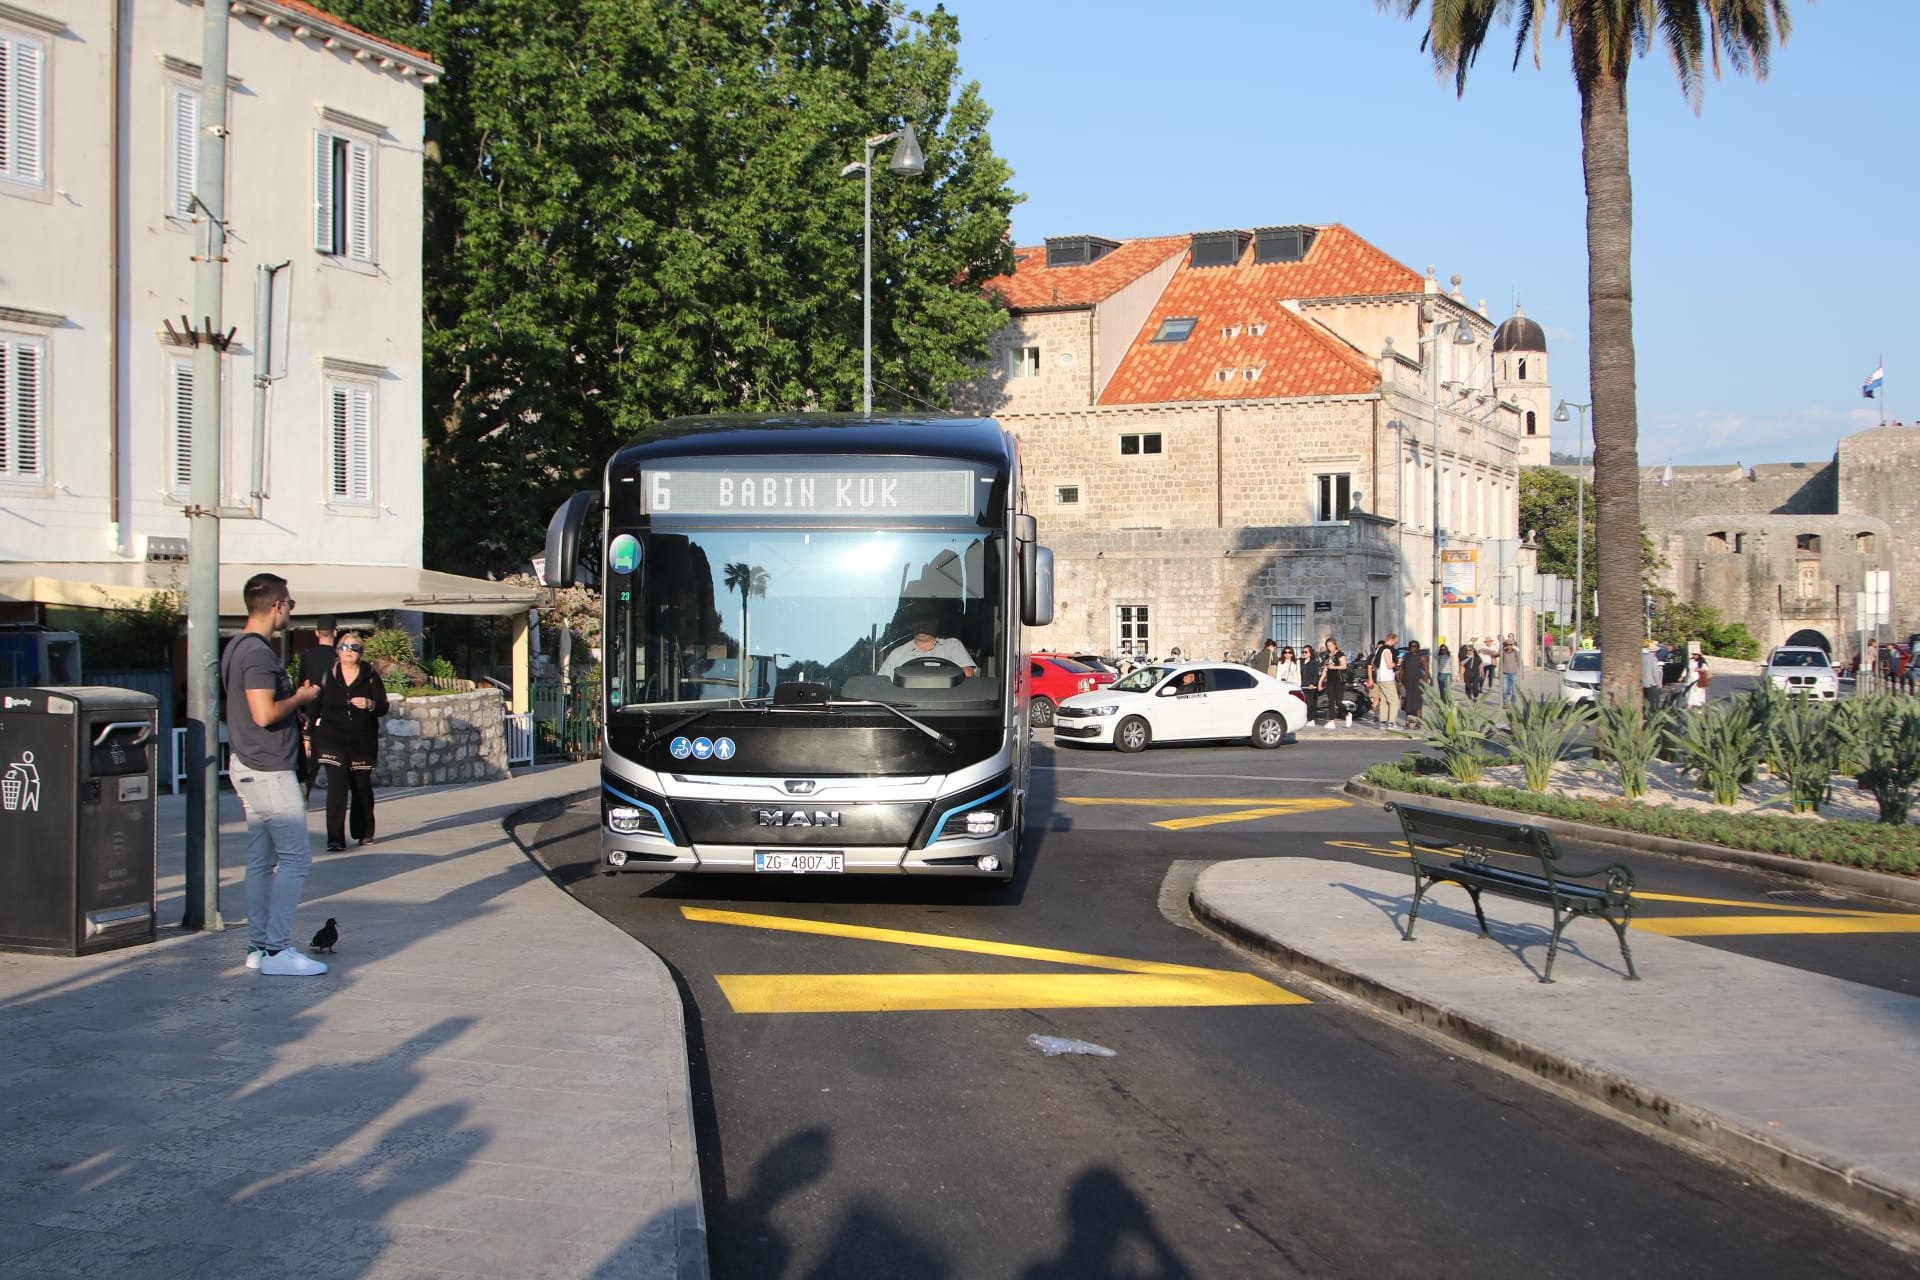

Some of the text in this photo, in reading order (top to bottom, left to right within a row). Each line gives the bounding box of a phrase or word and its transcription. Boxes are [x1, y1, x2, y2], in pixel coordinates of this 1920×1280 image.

[651, 471, 671, 511] 6
[719, 477, 897, 507] BABIN KUK
[1446, 552, 1471, 561] TAXI
[759, 810, 839, 828] MAN
[766, 855, 782, 870] ZG
